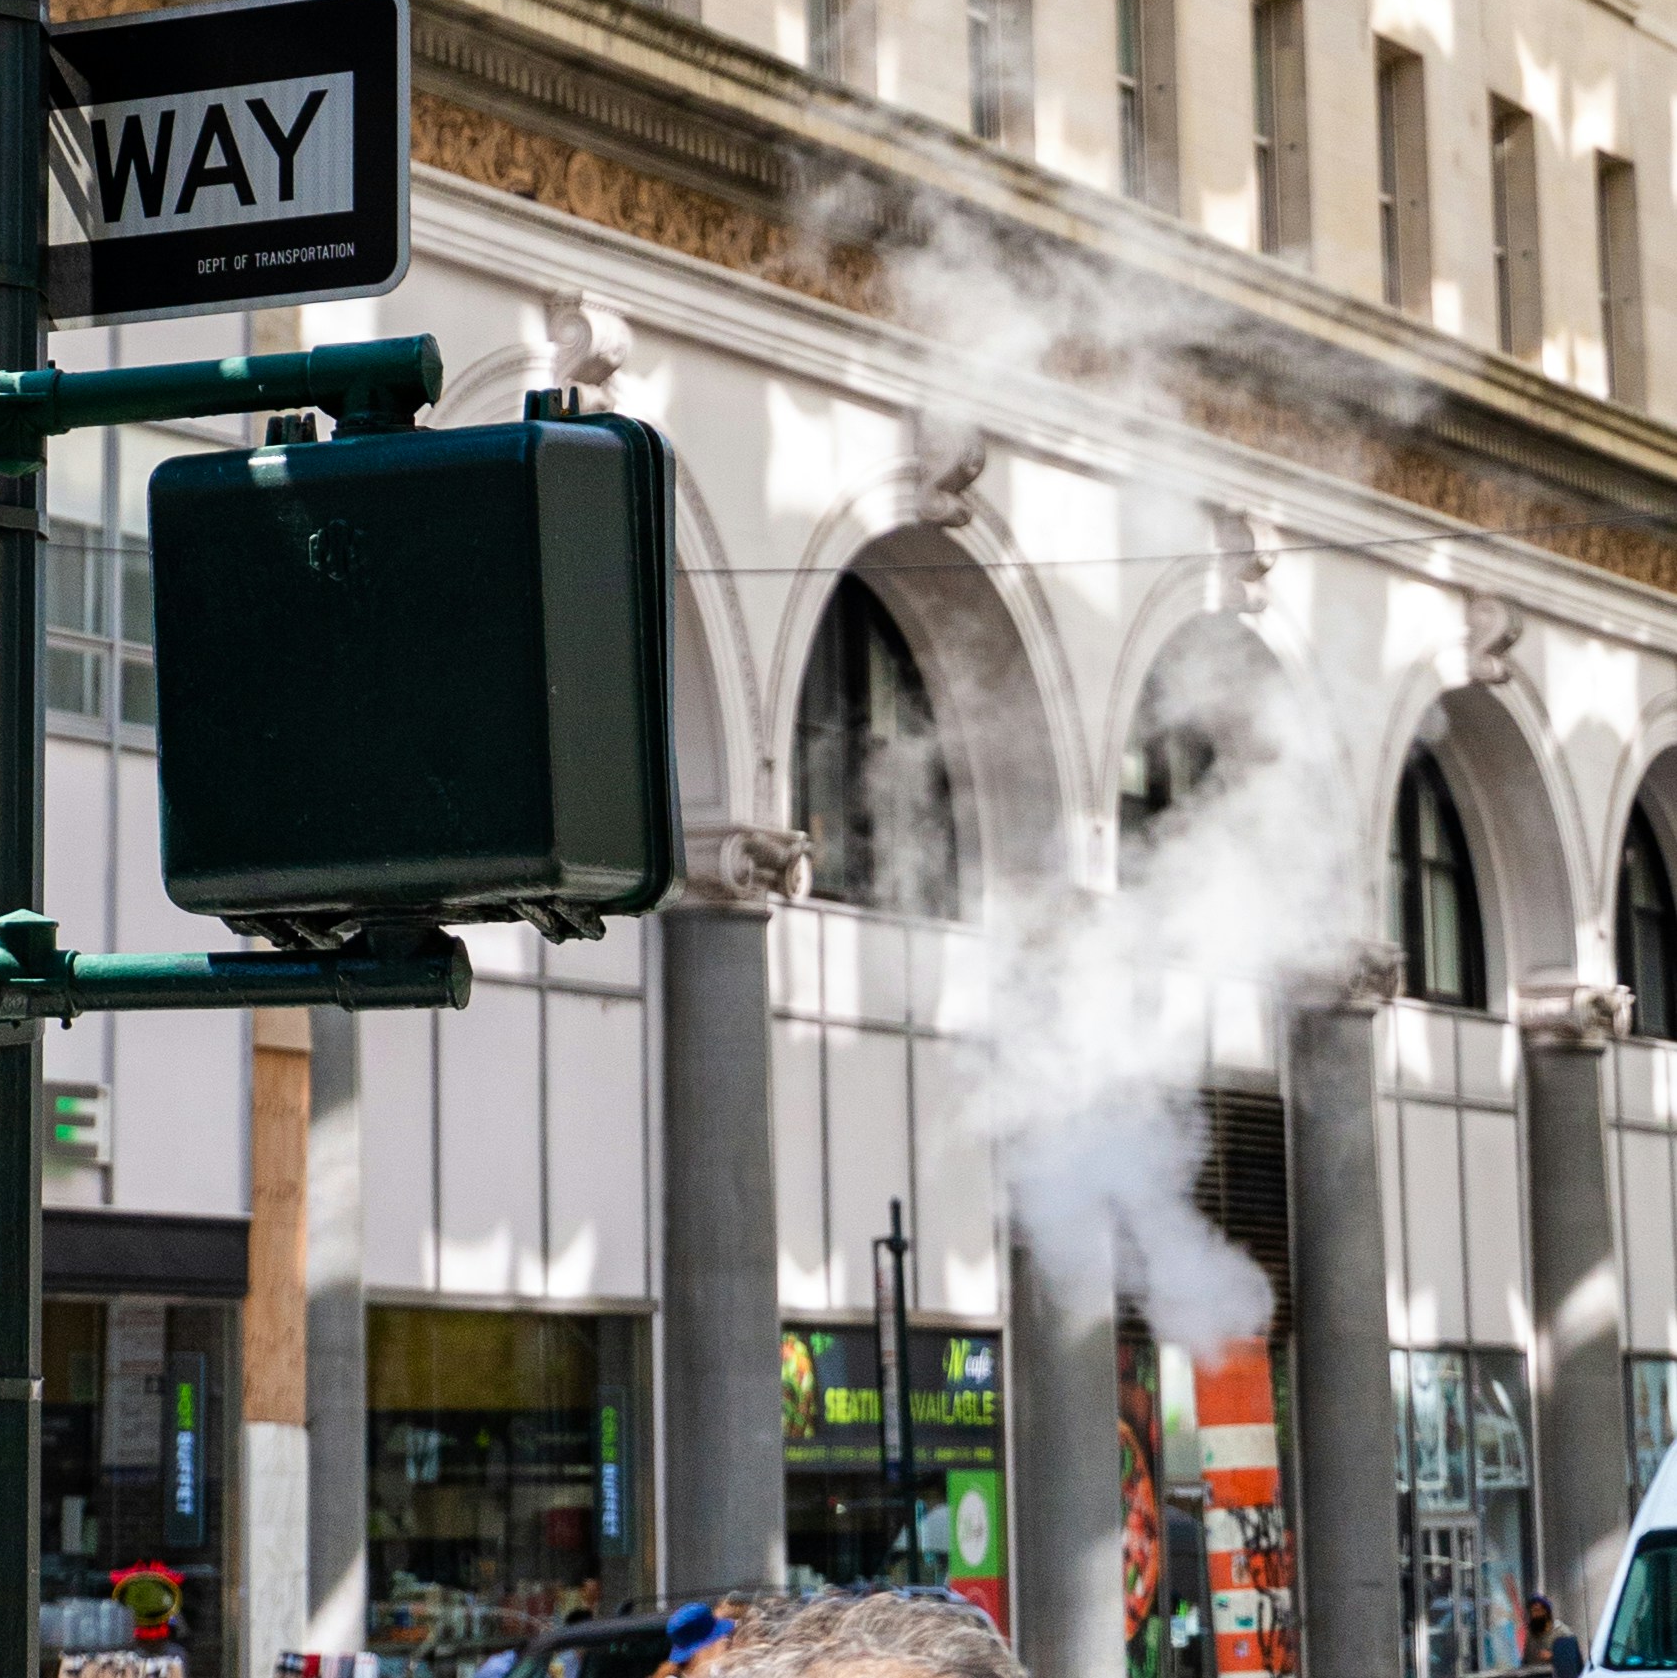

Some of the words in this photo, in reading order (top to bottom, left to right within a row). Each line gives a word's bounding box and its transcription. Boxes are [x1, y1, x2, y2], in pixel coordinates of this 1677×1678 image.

[91, 89, 328, 224] WAY
[234, 254, 249, 270] OF
[255, 242, 356, 268] TRANSPORTATION
